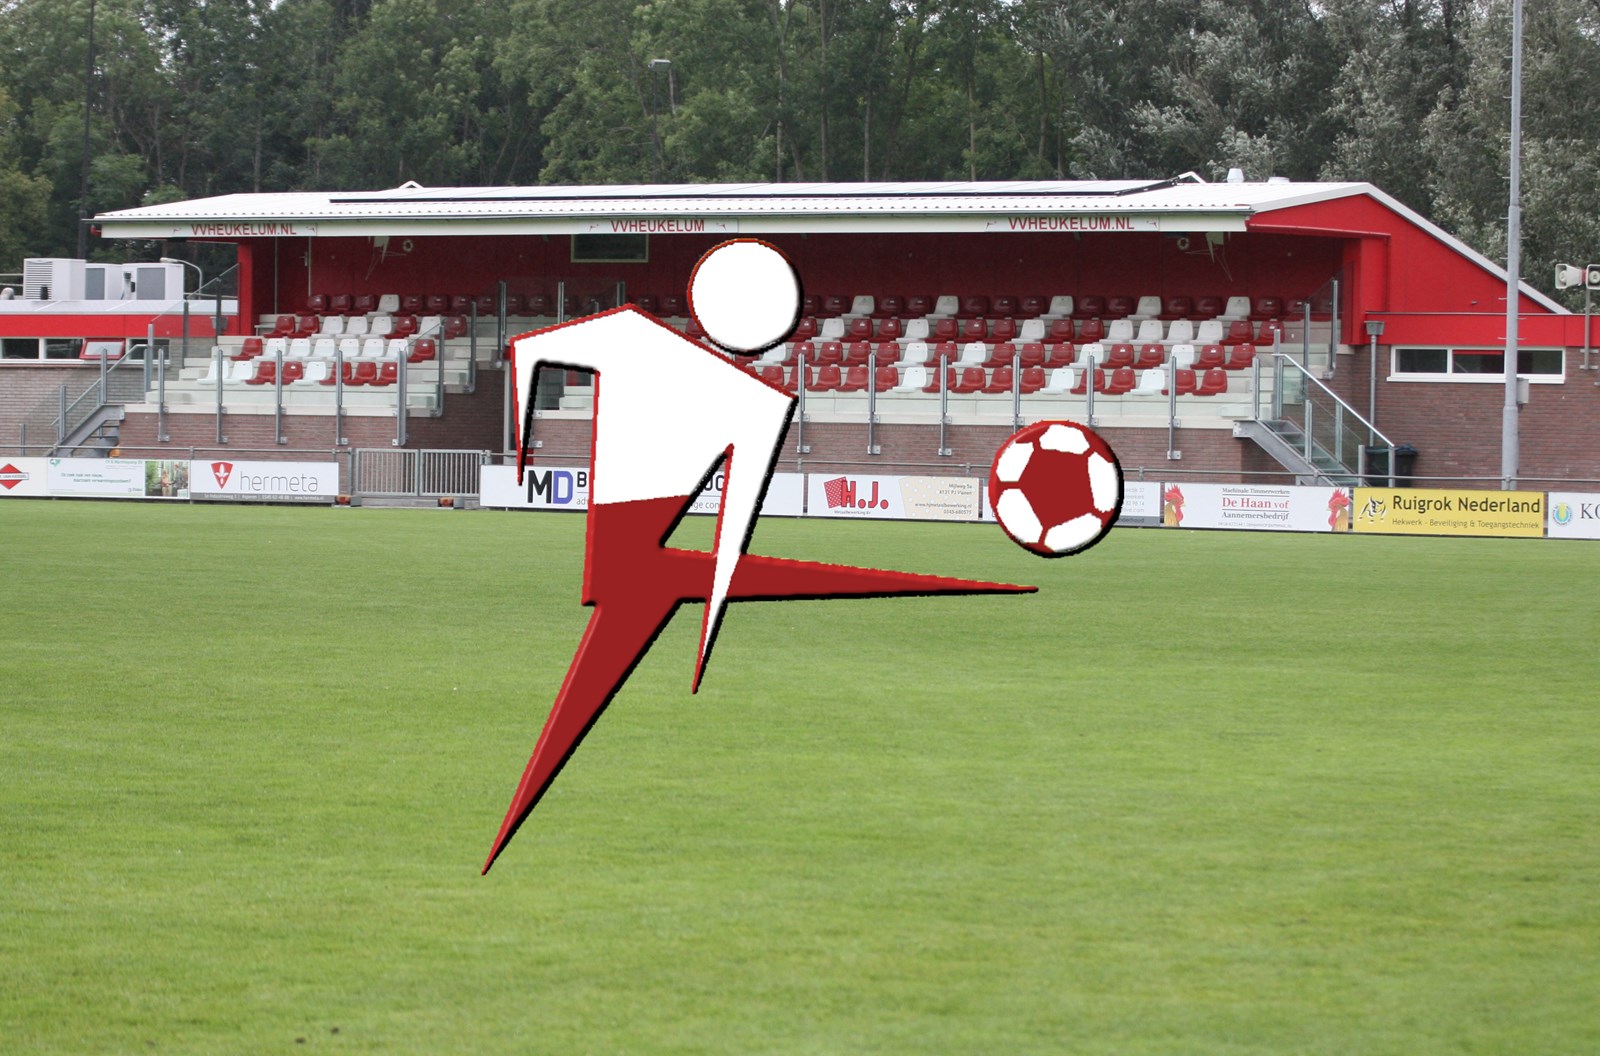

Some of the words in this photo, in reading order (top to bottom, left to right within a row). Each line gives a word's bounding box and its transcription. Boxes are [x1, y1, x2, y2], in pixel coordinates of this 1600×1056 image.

[190, 223, 297, 236] VVHEUKELUM.NL
[610, 219, 705, 232] VVHEUKELUM
[1008, 216, 1135, 230] VVHEUKELUM.NL
[240, 471, 318, 492] hermeta
[527, 470, 574, 504] MD
[1222, 497, 1237, 508] De
[1240, 498, 1271, 509] Haan
[1274, 500, 1289, 509] vof
[1392, 496, 1453, 514] Ruigrok
[1458, 497, 1540, 513] Nederland
[1221, 511, 1290, 521] Aannemersbedrijf
[1392, 518, 1423, 526] Hekwerk
[1429, 519, 1468, 529] Beveiliging
[1469, 520, 1475, 528] &
[1478, 519, 1540, 529] Toegangstechniek
